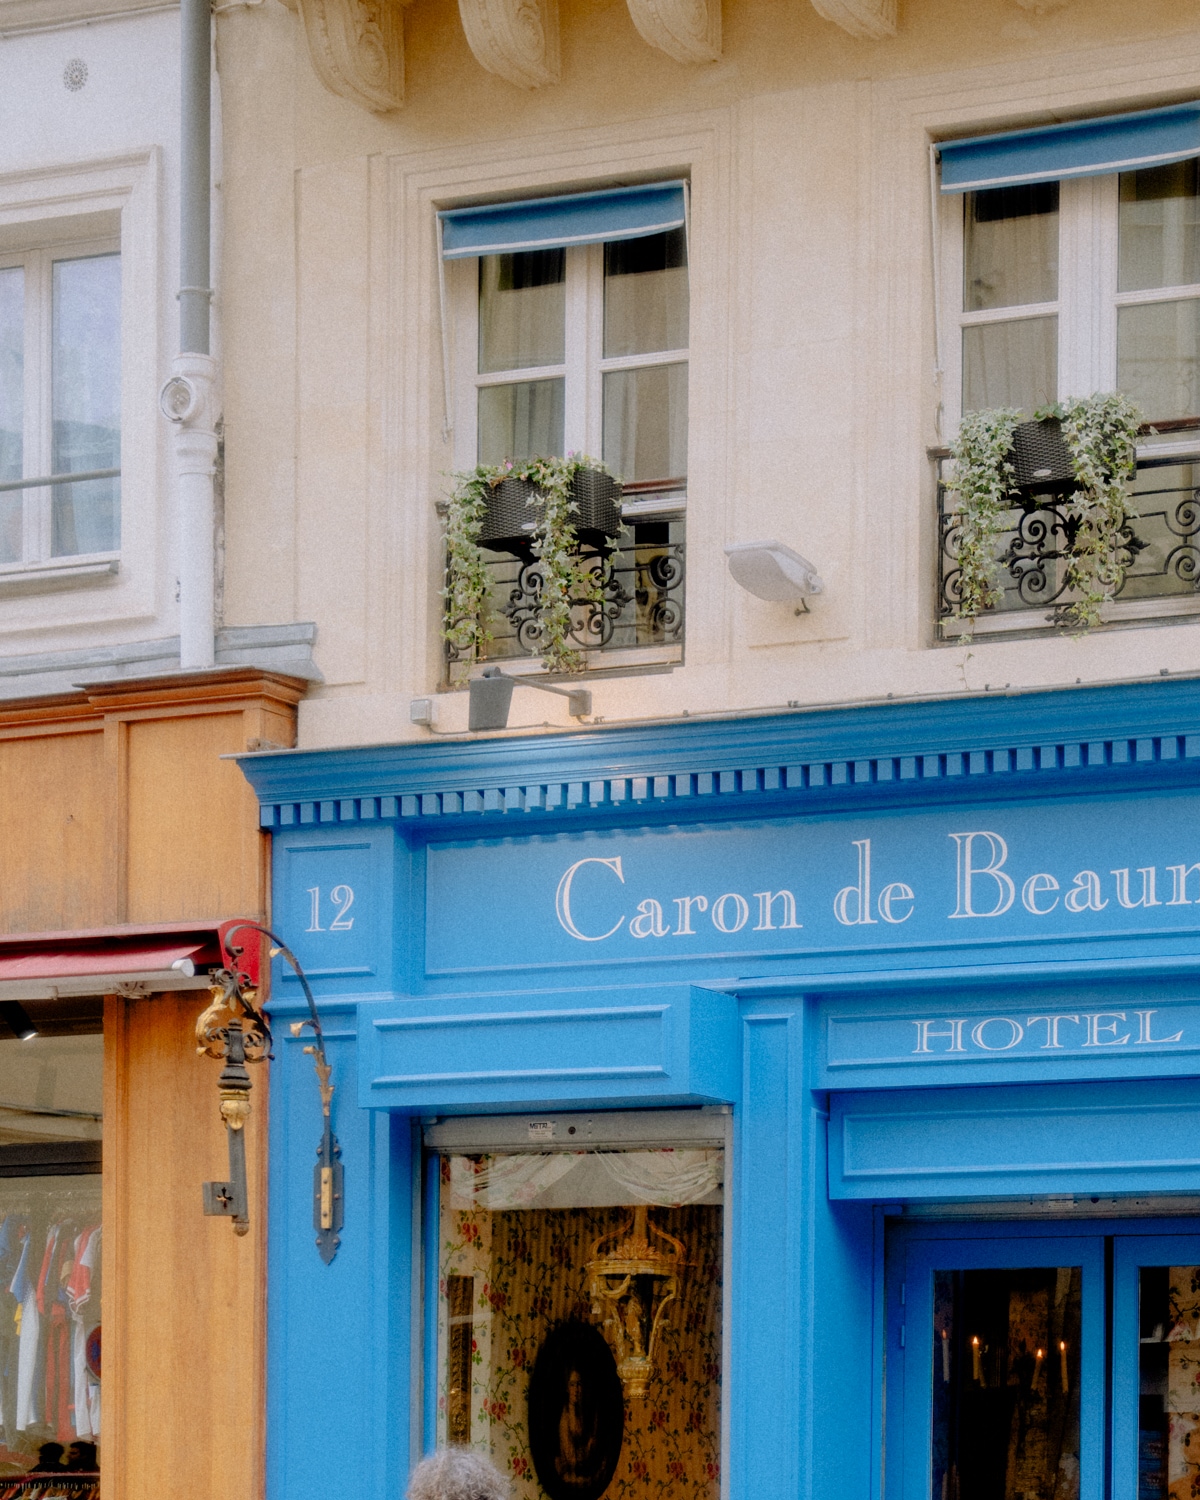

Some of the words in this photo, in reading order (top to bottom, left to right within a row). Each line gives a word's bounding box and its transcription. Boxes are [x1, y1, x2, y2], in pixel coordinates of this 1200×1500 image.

[305, 884, 355, 932] 12
[555, 856, 803, 942] Caron
[833, 838, 915, 926] de
[912, 1010, 1184, 1054] HOTEL
